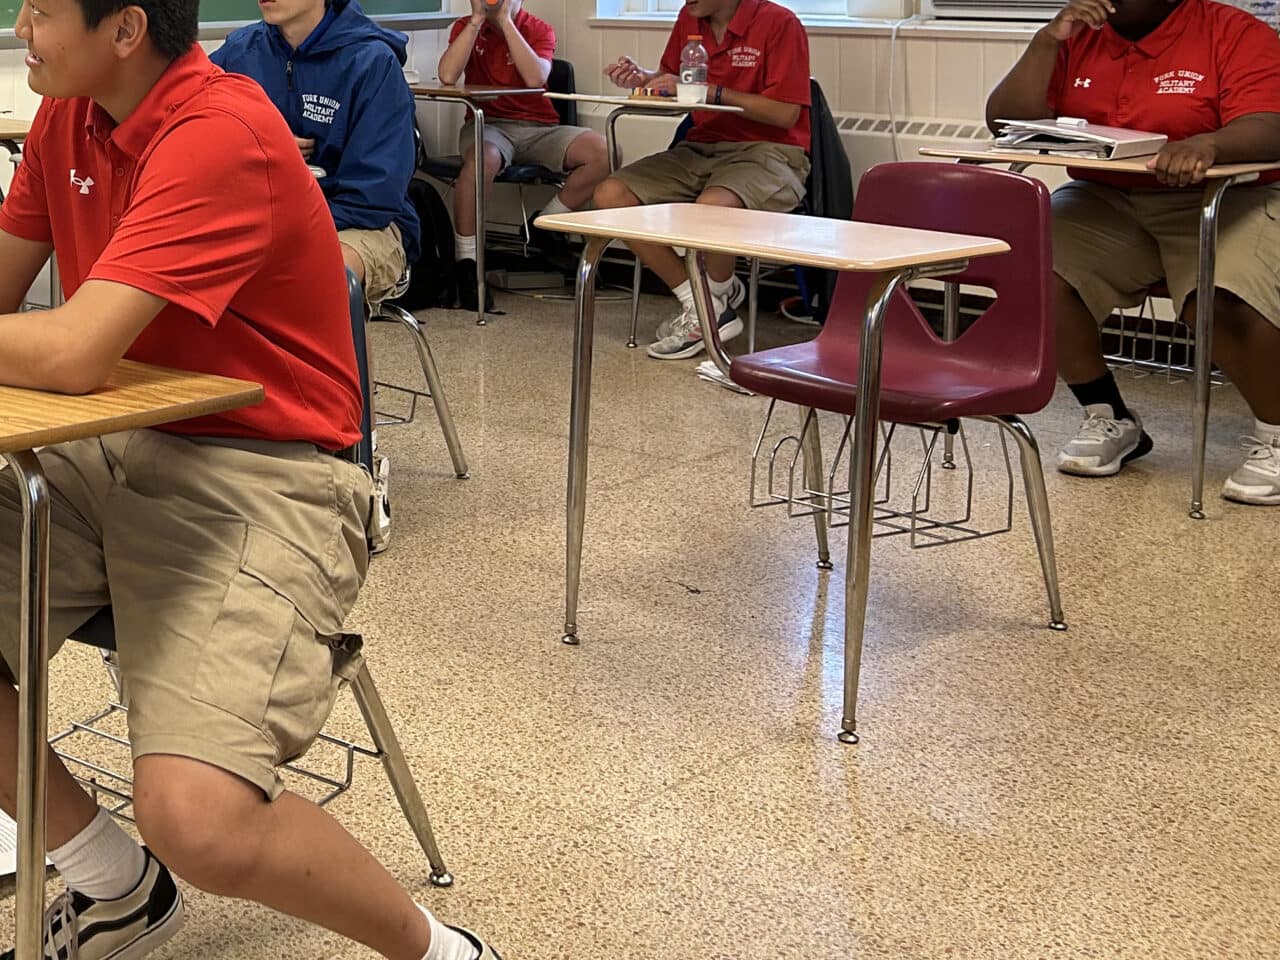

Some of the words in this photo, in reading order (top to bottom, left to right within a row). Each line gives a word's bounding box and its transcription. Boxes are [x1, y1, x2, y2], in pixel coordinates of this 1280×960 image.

[681, 70, 693, 83] G
[1178, 69, 1205, 81] UNION
[1160, 79, 1196, 87] MILITARY
[1156, 86, 1196, 94] ACADEMY
[303, 102, 335, 117] MILITARY
[319, 96, 340, 110] UNION
[302, 110, 334, 124] ACADEMY
